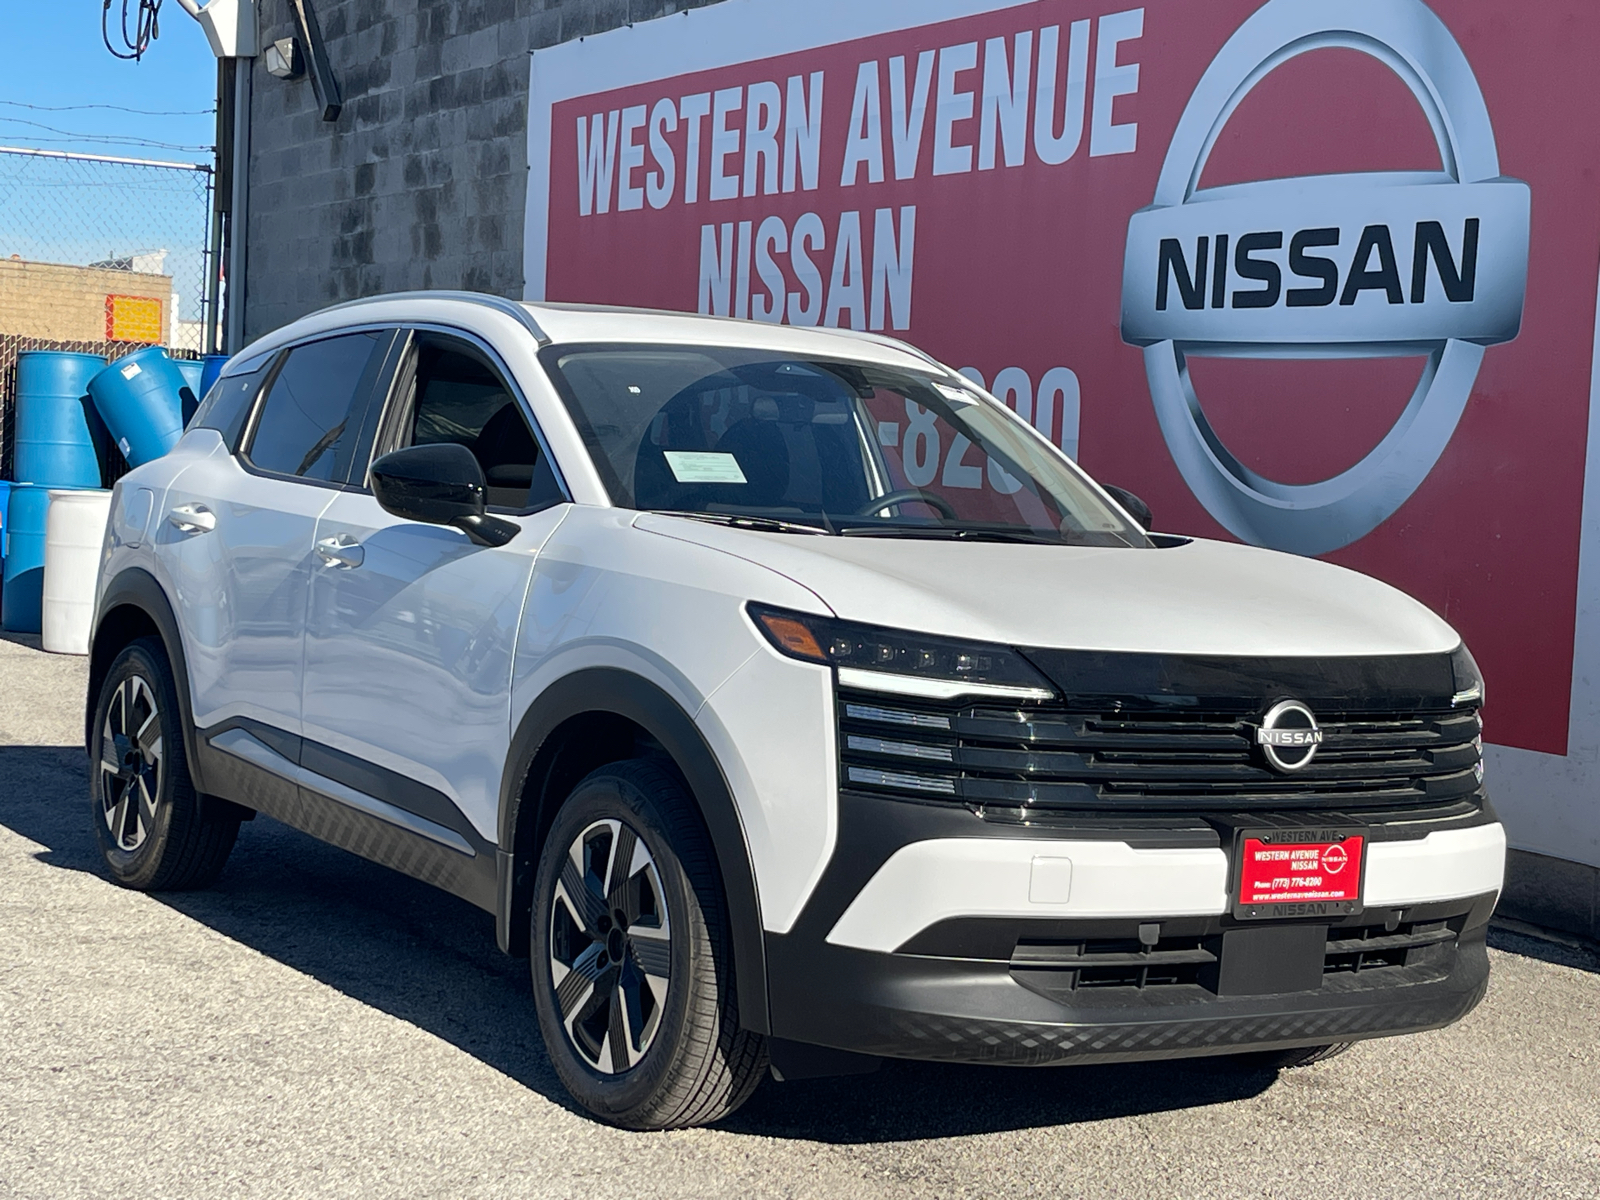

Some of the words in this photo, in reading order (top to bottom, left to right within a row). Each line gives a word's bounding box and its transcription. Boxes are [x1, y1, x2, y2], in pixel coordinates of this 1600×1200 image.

[577, 70, 823, 216] WESTERN
[840, 7, 1145, 187] AVENUE
[698, 205, 916, 331] NISSAN
[1156, 218, 1480, 311] NISSAN
[1260, 731, 1323, 744] NISSAN
[1272, 831, 1317, 842] WESTERN
[1255, 851, 1289, 861] WESTERN
[1291, 850, 1320, 860] AVENUE
[1291, 861, 1318, 871] NISSAN
[1272, 878, 1290, 890] (773)
[1291, 876, 1322, 887] 776-8200
[1273, 904, 1327, 916] NISSAN
